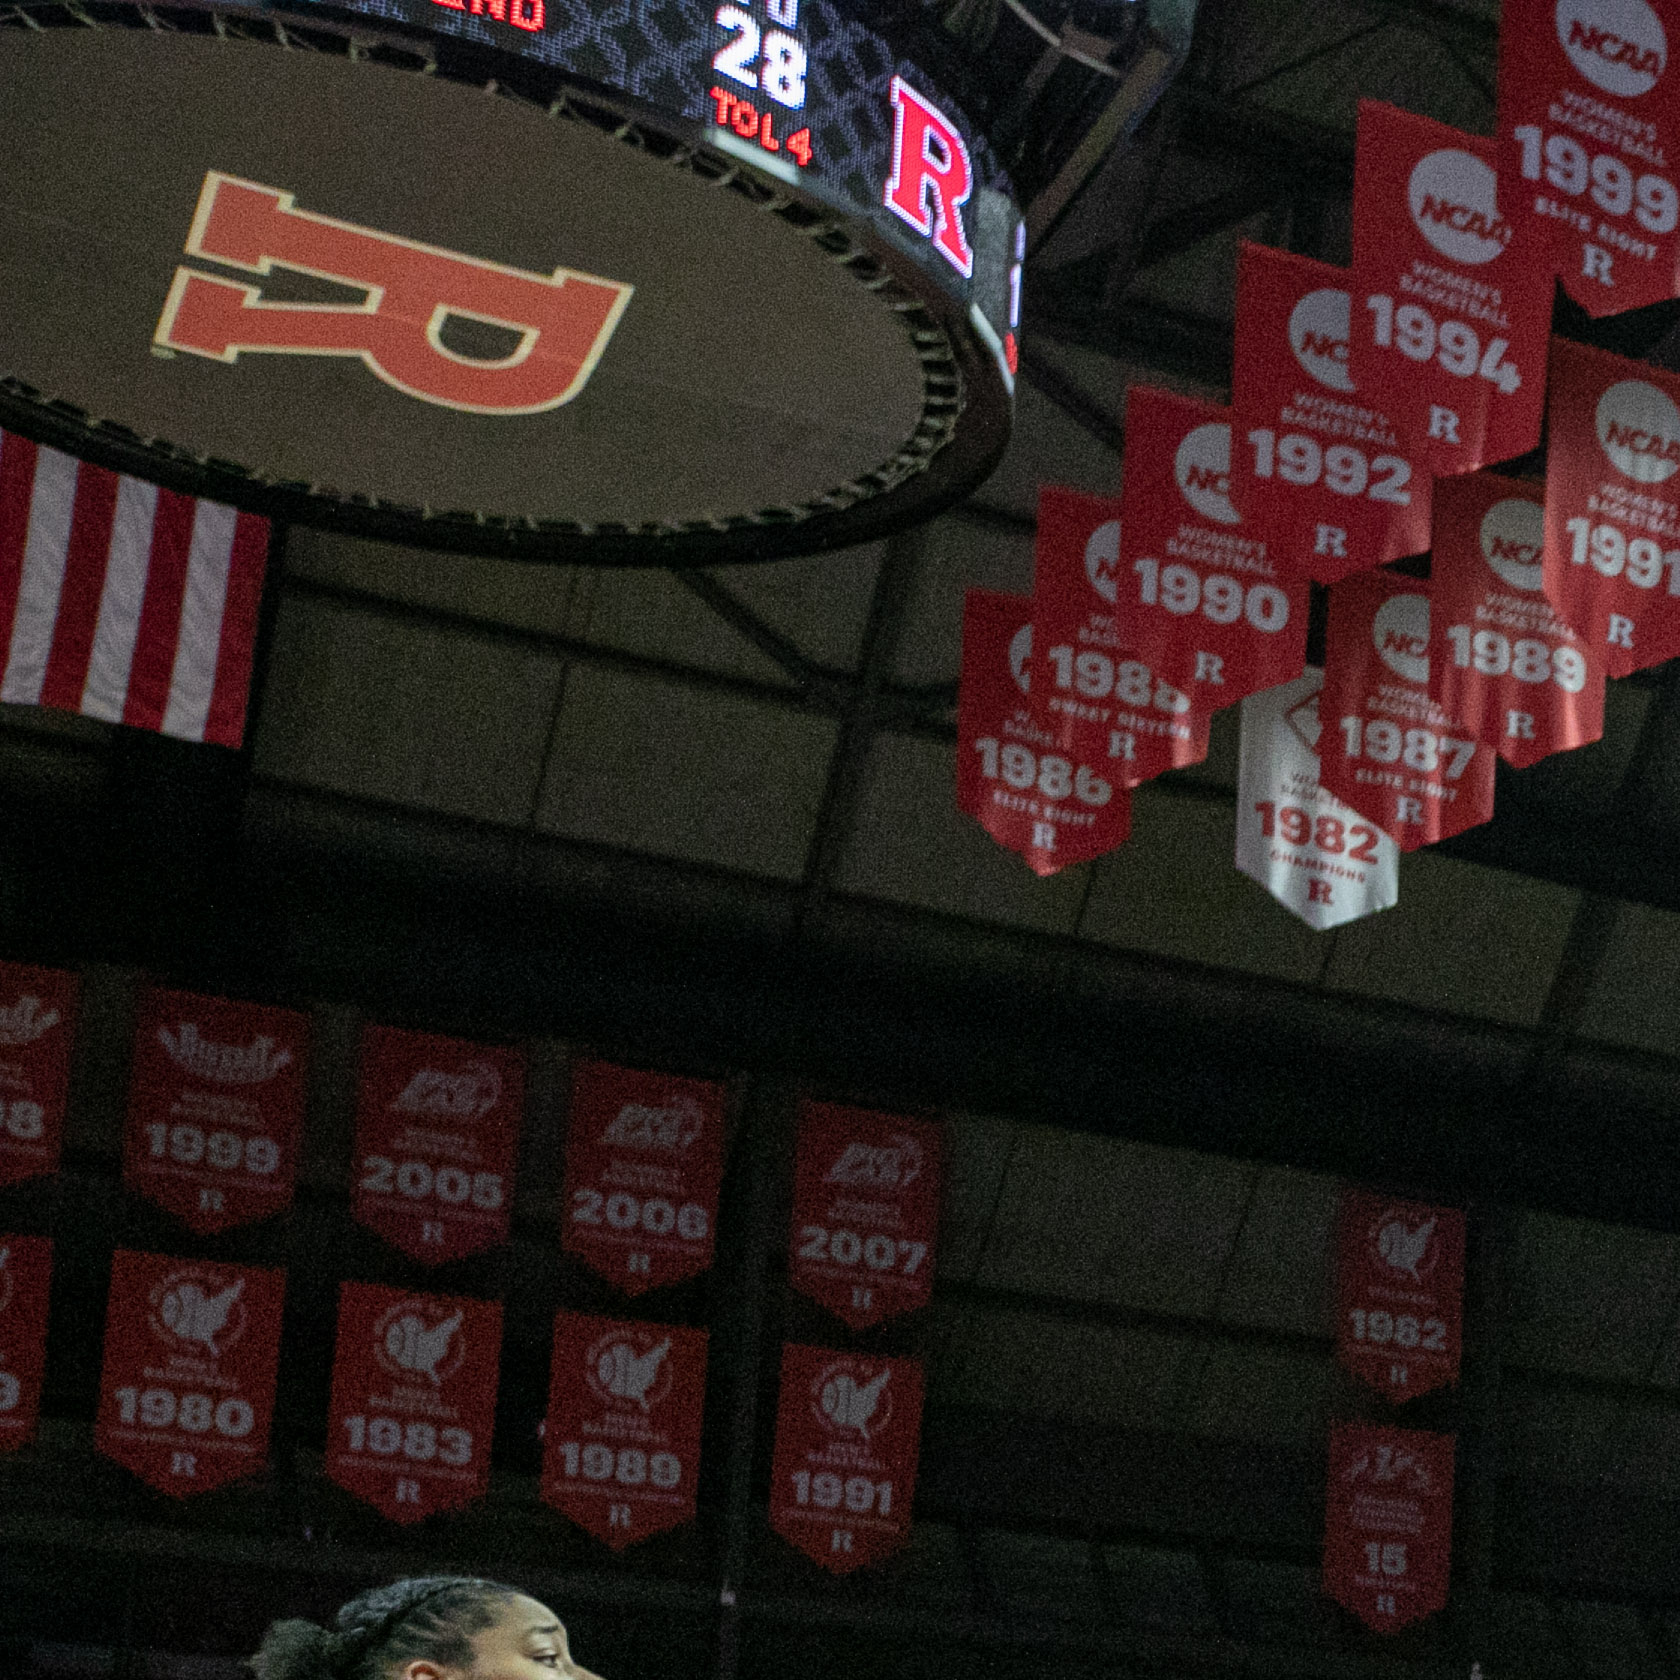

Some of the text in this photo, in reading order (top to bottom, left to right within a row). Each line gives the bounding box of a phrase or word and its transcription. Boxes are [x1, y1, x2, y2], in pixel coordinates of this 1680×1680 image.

[713, 8, 807, 110] 28
[1567, 19, 1660, 80] NCAA
[710, 86, 812, 167] TOL 4
[884, 75, 973, 278] R
[1513, 125, 1680, 234] 1999
[153, 168, 635, 416] R
[1581, 243, 1614, 286] R
[1367, 294, 1521, 393] 1994
[1429, 405, 1461, 443] R
[1248, 429, 1411, 506] 1992
[1315, 524, 1348, 558] R
[1134, 558, 1290, 632] 1990
[1446, 624, 1586, 693] 1989
[1608, 614, 1636, 649] R
[1195, 651, 1225, 685] R
[1340, 716, 1476, 780] 1987
[1254, 801, 1380, 866] 1982
[145, 1121, 280, 1174] 1999
[798, 1225, 928, 1275] 2007
[114, 1386, 255, 1437] 1980
[791, 1469, 893, 1516] 1991
